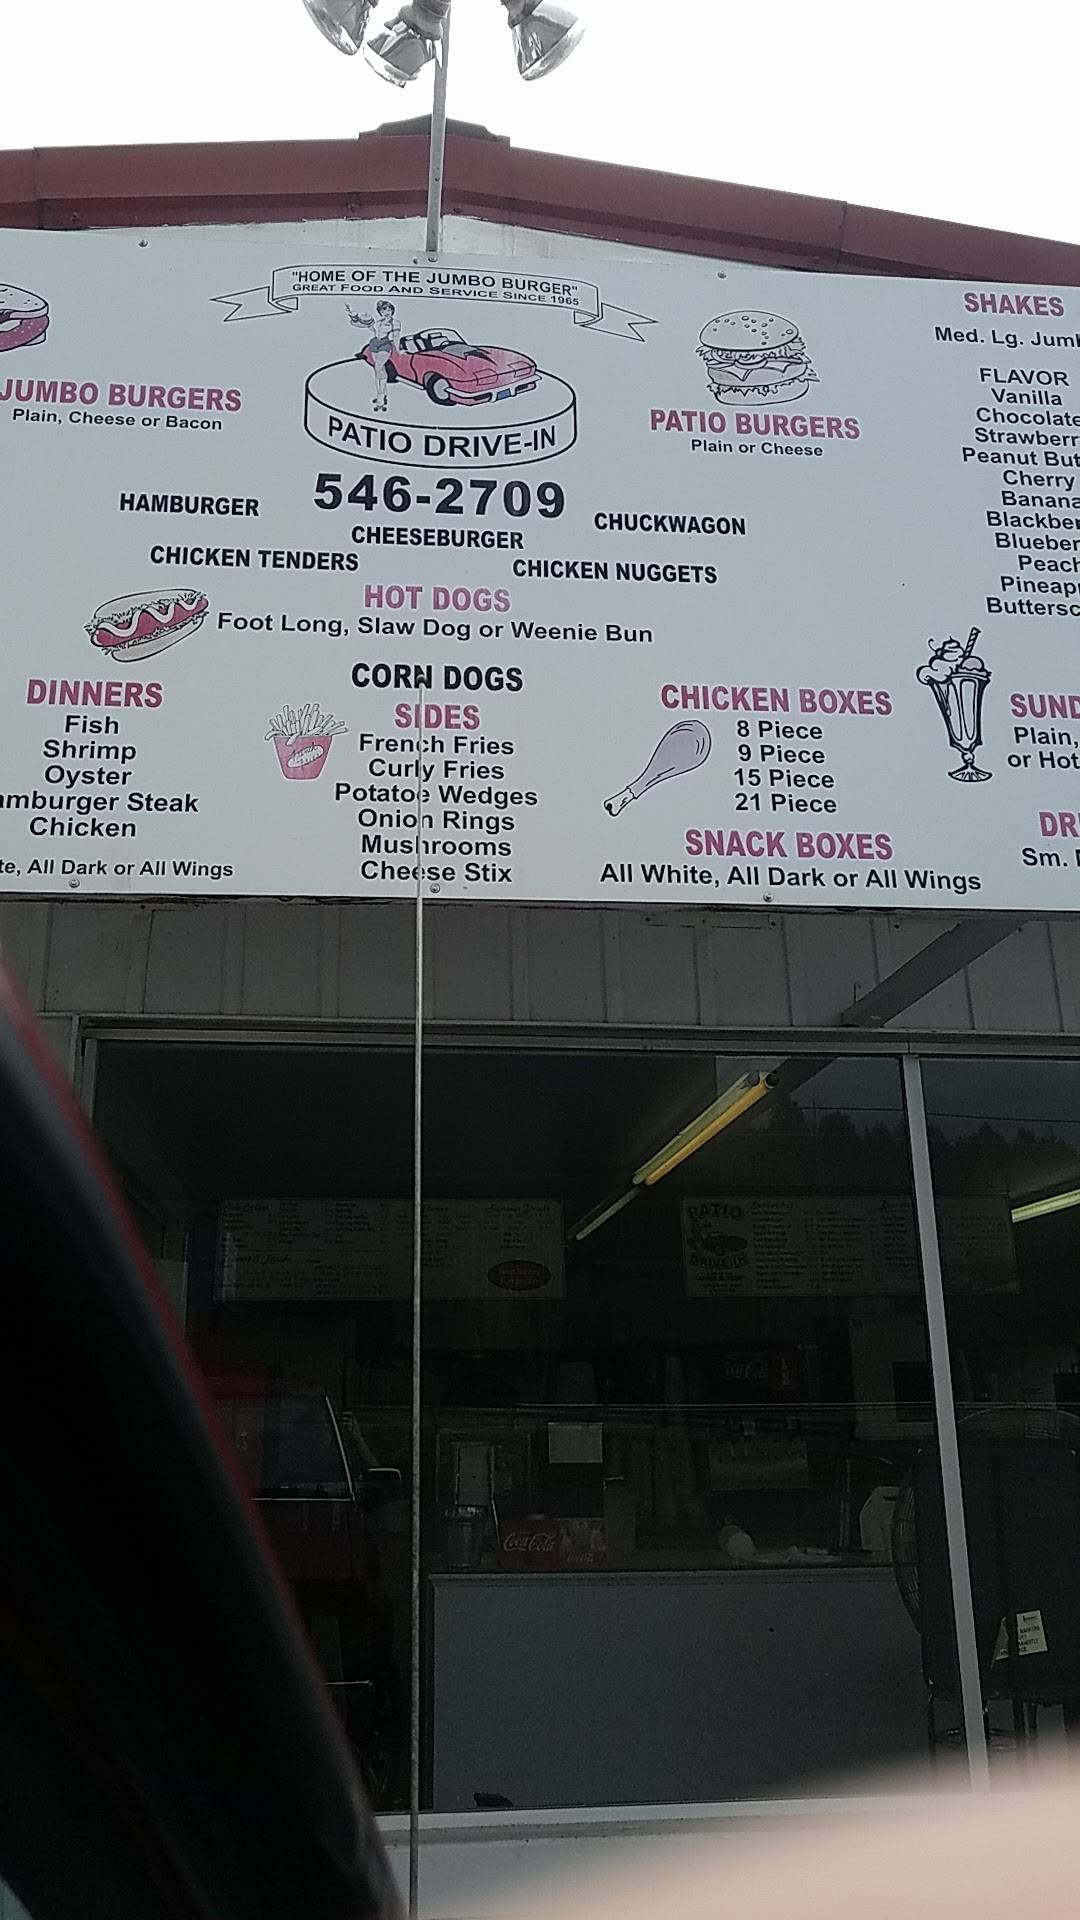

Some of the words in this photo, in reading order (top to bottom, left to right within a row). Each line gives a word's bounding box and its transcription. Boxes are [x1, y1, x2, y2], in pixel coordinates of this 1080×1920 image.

[292, 271, 345, 282] "HOME
[352, 270, 376, 281] OF
[382, 271, 420, 283] THE
[426, 273, 495, 287] JUMBO
[502, 277, 578, 295] BURGER"
[341, 284, 383, 292] FOOD
[430, 287, 498, 298] SERVICE
[503, 292, 546, 302] SINCE
[551, 296, 579, 305] 1965
[964, 293, 1064, 316] SHAKES
[935, 327, 984, 343] Med.
[992, 330, 1023, 348] Lg.
[980, 368, 1069, 386] FLAVOR
[0, 379, 98, 404] JUMBO
[109, 384, 241, 411] BURGERS
[991, 388, 1062, 405] Vanilla
[13, 409, 61, 424] Plain,
[69, 411, 135, 425] Cheese
[142, 418, 160, 426] or
[166, 416, 221, 430] Bacon
[651, 409, 726, 433] PATIO
[736, 413, 859, 439] BURGERS
[976, 407, 1080, 427] Chocolate
[328, 416, 411, 453] PATIO
[423, 425, 556, 459] DRIVE-IN
[692, 439, 732, 452] Plain
[739, 444, 756, 453] or
[761, 442, 823, 456] Cheese
[962, 447, 1038, 465] Peanut
[1003, 470, 1074, 491] Cherry
[120, 493, 259, 516] HAMBURGER
[314, 473, 564, 518] 546-2709
[1002, 490, 1080, 509] Banana
[594, 513, 745, 535] CHUCKWAGON
[352, 526, 524, 549] CHEESEBURGER
[151, 545, 250, 567] CHICKEN
[258, 550, 358, 571] TENDERS
[1018, 555, 1080, 572] Peach
[513, 559, 608, 579] CHICKEN
[616, 563, 717, 583] NUGGETS
[1001, 576, 1080, 598] Pineap
[365, 585, 422, 609] HOT
[433, 587, 510, 612] DOGS
[218, 612, 273, 631] Foot
[282, 615, 348, 637] Long,
[358, 617, 415, 635] Slaw
[424, 619, 470, 641] Dog
[480, 625, 504, 637] or
[511, 622, 597, 640] Weenie
[606, 625, 652, 642] Bun
[352, 663, 432, 689] CORN
[444, 666, 523, 691] DOGS
[27, 679, 162, 708] DINNERS
[662, 685, 789, 712] CHICKEN
[799, 689, 892, 715] BOXES
[65, 715, 118, 734] Fish
[394, 703, 480, 730] SIDES
[737, 720, 749, 737] 8
[759, 720, 822, 739] Piece
[1014, 726, 1078, 748] Plain,
[43, 740, 136, 764] Shrimp
[359, 733, 445, 754] French
[454, 736, 514, 755] Fries
[738, 744, 751, 761] 9
[760, 745, 825, 763] Piece
[368, 758, 435, 782] Curly
[444, 760, 504, 779] Fries
[1008, 754, 1031, 768] or
[45, 765, 132, 789] Oyster
[734, 768, 761, 786] 15
[769, 769, 834, 788] Piece
[127, 792, 198, 812] Steak
[335, 783, 430, 804] Potatoe
[438, 785, 537, 809] Wedges
[735, 793, 760, 811] 21
[771, 794, 836, 813] Piece
[30, 817, 135, 837] Chicken
[357, 808, 433, 830] Onion
[444, 810, 514, 834] Rings
[1039, 812, 1080, 837] DR
[361, 834, 512, 856] Mushrooms
[686, 829, 787, 857] SNACK
[796, 833, 892, 860] BOXES
[1022, 848, 1067, 866] Sm.
[27, 859, 54, 874] All
[62, 860, 107, 875] Dark
[114, 864, 135, 875] or
[139, 861, 165, 875] All
[173, 861, 233, 880] Wings
[360, 861, 456, 883] Cheese
[465, 863, 512, 882] Stix
[600, 864, 632, 882] All
[641, 864, 719, 888] White,
[727, 866, 759, 885] All
[768, 867, 826, 886] Dark
[834, 873, 858, 887] or
[866, 869, 897, 888] All
[904, 870, 981, 894] Wings
[688, 1203, 742, 1218] PATIO
